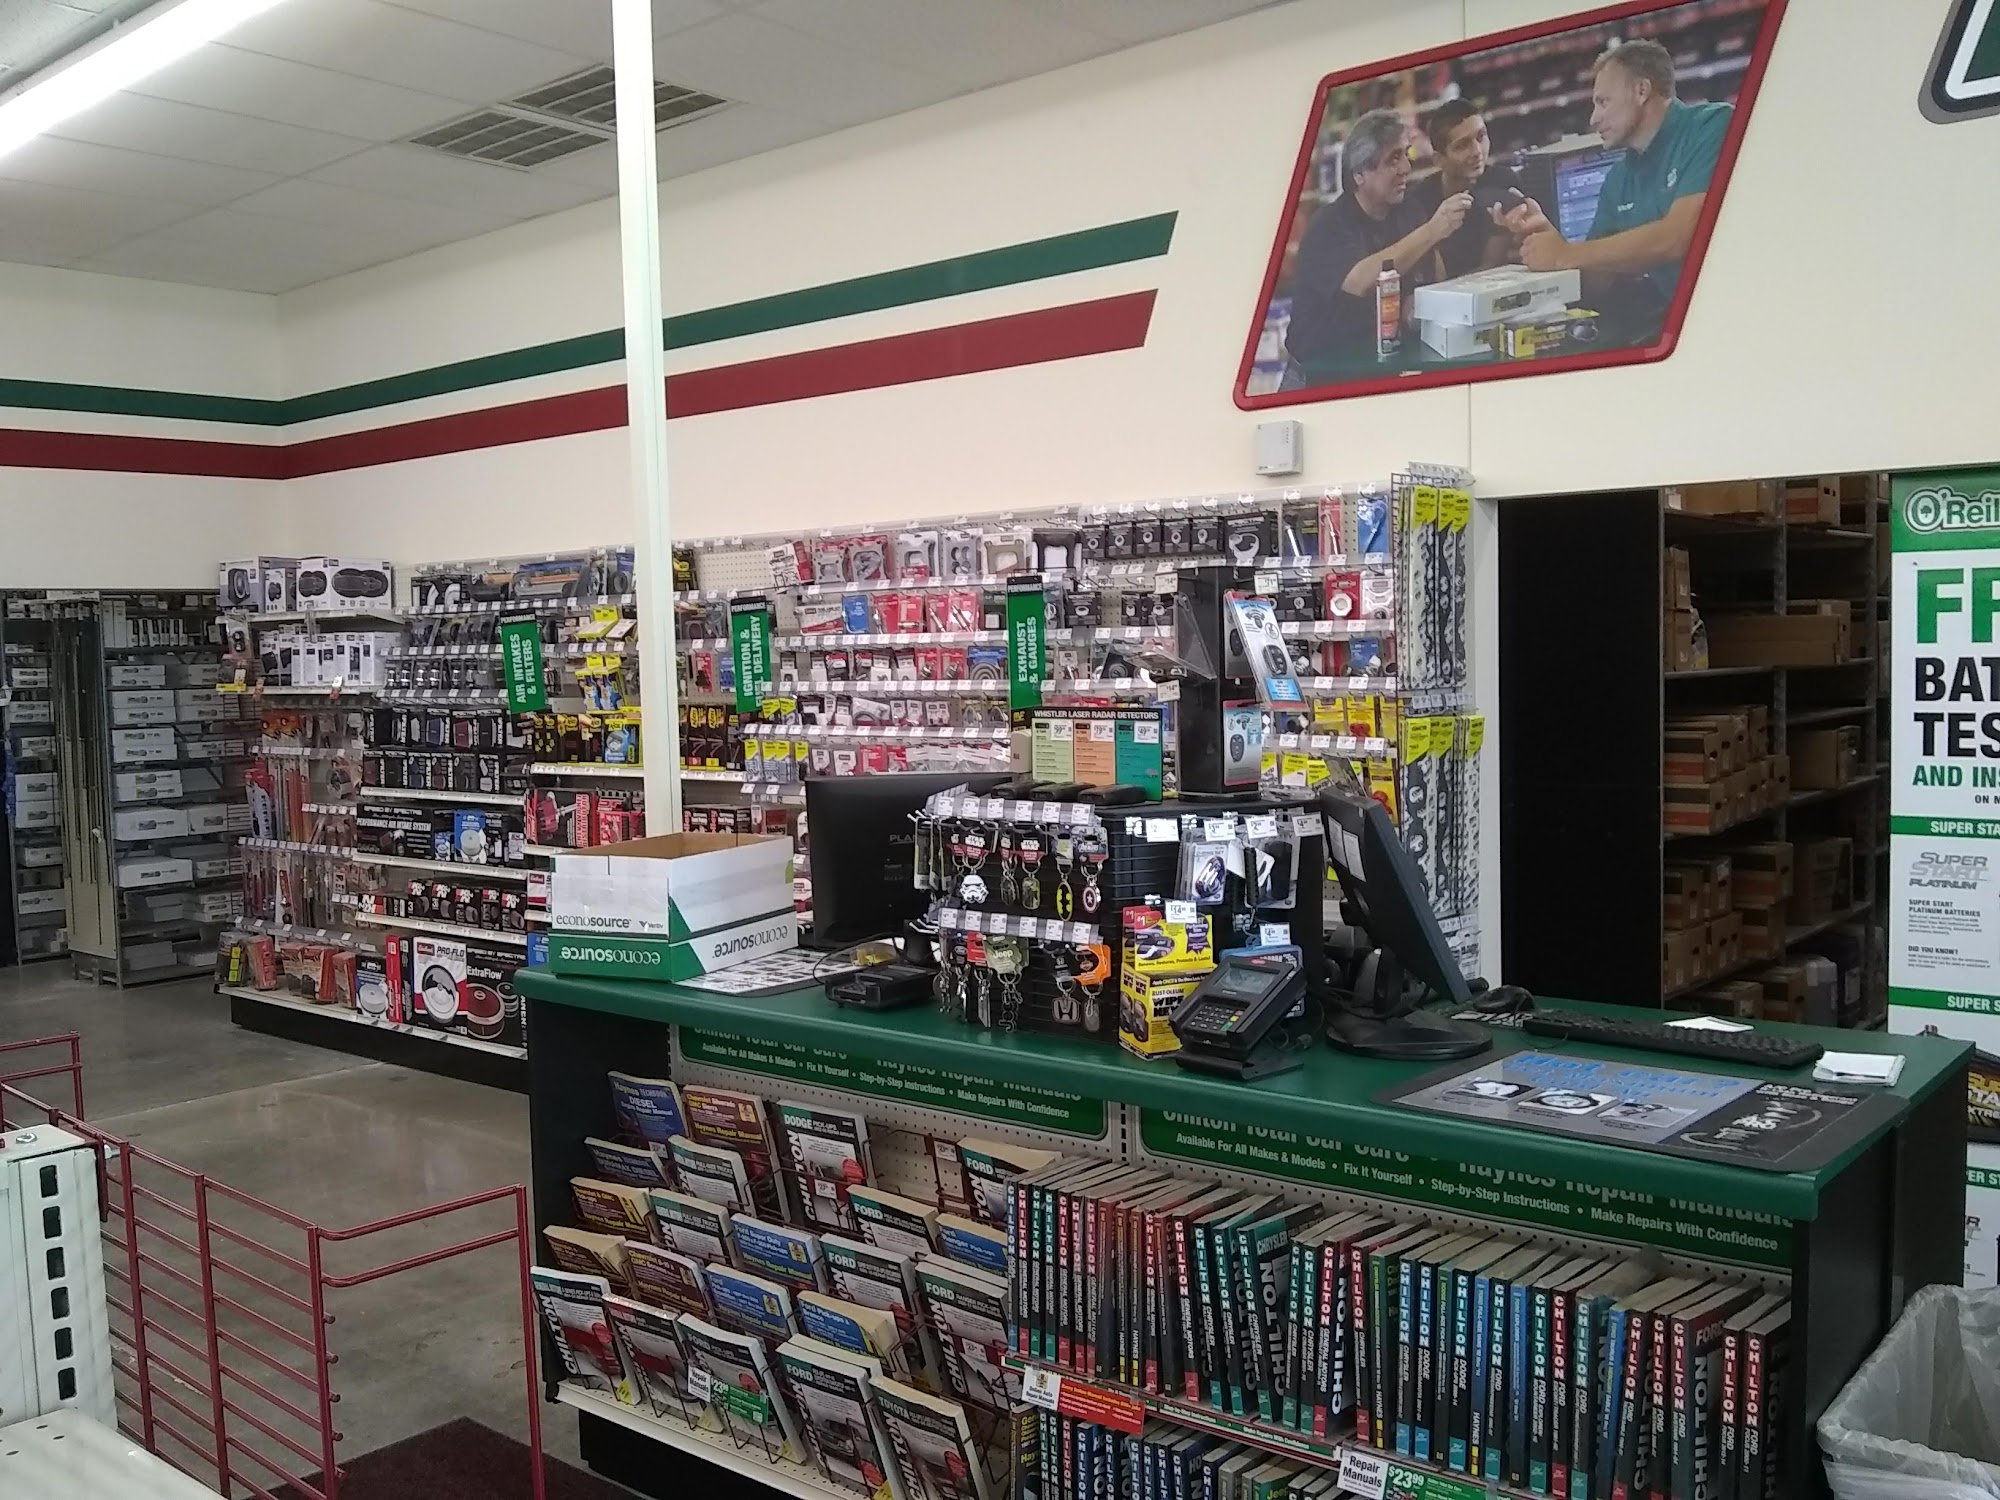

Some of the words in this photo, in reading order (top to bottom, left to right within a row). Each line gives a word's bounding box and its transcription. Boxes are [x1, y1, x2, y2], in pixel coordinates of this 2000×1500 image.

[731, 602, 766, 612] PERFORMANCE
[1007, 583, 1043, 593] PERFORMANCE
[501, 614, 535, 623] PERFORMANCE
[740, 629, 750, 639] &
[510, 633, 524, 681] INTAKES
[522, 639, 535, 682] FILTERS
[750, 616, 763, 674] DELIVERY
[1016, 621, 1028, 682] EXHAUST
[1027, 616, 1038, 669] GAUGES
[527, 685, 537, 694] &
[741, 643, 753, 696] IGNITION
[1029, 673, 1038, 684] &
[1915, 656, 2000, 702] BAT
[515, 683, 526, 703] AIR
[1034, 710, 1067, 718] WHISTLER
[1068, 710, 1090, 718] LASER
[1091, 711, 1116, 719] RADAR
[1117, 711, 1158, 719] DETECTORS
[1913, 712, 2000, 758] TES
[1912, 765, 1963, 787] AND
[1972, 766, 2000, 788] IN
[1975, 794, 1989, 804] ON
[356, 818, 388, 828] PERFORMANCE
[397, 821, 412, 829] INTAKE
[766, 826, 785, 834] Holley
[1930, 820, 1973, 835] SUPER
[1920, 852, 1988, 867] SUPER
[1909, 879, 1977, 890] PLATINUM
[1909, 899, 1930, 907] SUPER
[1933, 900, 1953, 908] START
[556, 912, 630, 929] econosource
[1909, 907, 1942, 915] PLATINUM
[1944, 908, 1981, 917] BATTERIES
[436, 946, 464, 957] PRO-FLO
[560, 946, 661, 965] econosource
[712, 926, 788, 959] econosource
[993, 949, 1013, 960] Jeep
[1921, 946, 1934, 954] YOU
[1935, 947, 1959, 955] KNOW?
[466, 966, 501, 980] ExtraFlow
[1152, 989, 1184, 997] RUST-OLEUM
[1947, 996, 1990, 1012] SUPER
[613, 1082, 640, 1096] Haynes
[629, 1096, 657, 1109] DIESEL
[702, 1043, 727, 1056] Available
[728, 1048, 737, 1057] For
[738, 1050, 747, 1058] All
[748, 1052, 767, 1063] Makes
[769, 1055, 774, 1064] &
[775, 1056, 796, 1068] Models
[807, 1061, 816, 1071] Fix
[818, 1063, 823, 1071] It
[824, 1064, 849, 1078] Yourself
[860, 1072, 903, 1090] Step-by-Step
[904, 1080, 945, 1096] Instructions
[958, 1089, 977, 1102] Make
[978, 1093, 1006, 1107] Repairs
[1008, 1098, 1025, 1111] With
[1027, 1102, 1069, 1118] Confidence
[694, 1123, 716, 1133] Haynes
[717, 1127, 737, 1137] Repair
[738, 1131, 763, 1140] Manual
[784, 1114, 813, 1129] DODGE
[813, 1120, 837, 1131] PICK-UPS
[787, 1129, 815, 1221] CHILTON
[966, 1157, 994, 1175] FORD
[853, 1202, 884, 1220] FORD
[1176, 1132, 1215, 1150] Available
[1218, 1140, 1233, 1152] For
[1235, 1142, 1247, 1154] All
[1249, 1145, 1279, 1161] Makes
[1281, 1151, 1288, 1162] &
[1291, 1153, 1326, 1170] Models
[1344, 1162, 1359, 1175] Fix
[1361, 1165, 1369, 1178] It
[1371, 1167, 1412, 1185] Yourself
[1431, 1178, 1501, 1203] Step-by-Step
[1503, 1191, 1570, 1215] Instructions
[1591, 1206, 1623, 1225] Make
[1627, 1213, 1673, 1233] Repairs
[1675, 1221, 1704, 1239] With
[1706, 1227, 1778, 1251] Confidence
[1007, 1185, 1015, 1259] CHILTON
[1018, 1189, 1027, 1258] CHILTON
[1032, 1189, 1040, 1259] CHILTON
[1045, 1194, 1053, 1263] CHILTON
[1059, 1196, 1067, 1266] CHILTON
[1086, 1203, 1095, 1277] CHILTON
[1256, 1231, 1289, 1255] CHRYSLER
[828, 1252, 856, 1269] FORD
[1145, 1213, 1155, 1286] CHILTON
[1174, 1221, 1188, 1296] CHILTON
[1195, 1228, 1211, 1304] CHILTON
[1214, 1235, 1230, 1310] CHILTON
[1238, 1234, 1256, 1311] CHILTON
[1289, 1246, 1299, 1321] CHILTON
[1304, 1251, 1316, 1328] CHILTON
[1320, 1246, 1334, 1326] CHILTON
[1352, 1250, 1364, 1329] CHILTON
[1400, 1262, 1411, 1344] CHILTON
[1259, 1262, 1286, 1396] CHILTON
[1419, 1267, 1431, 1347] CHILTON
[1455, 1275, 1468, 1357] CHILTON
[1491, 1284, 1505, 1367] CHILTON
[539, 1293, 580, 1375] CHILTON
[928, 1298, 967, 1394] CHILTON
[1332, 1277, 1347, 1415] CHILTON
[1534, 1294, 1546, 1377] CHILTON
[1553, 1295, 1565, 1379] CHILTON
[1576, 1303, 1590, 1388] CHILTON
[786, 1364, 813, 1381] FORD
[1624, 1317, 1642, 1399] CHILTON
[1652, 1320, 1664, 1406] CHILTON
[1673, 1322, 1685, 1409] CHILTON
[1722, 1335, 1736, 1423] CHILTON
[1029, 1386, 1042, 1394] Online
[1746, 1338, 1761, 1426] CHILTON
[880, 1397, 910, 1419] TOYOTA
[1472, 1411, 1480, 1445] HAYNES
[1040, 1412, 1050, 1481] CHILTON
[1050, 1416, 1058, 1485] CHILTON
[1063, 1420, 1072, 1489] CHILTON
[1349, 1455, 1380, 1474] Repair
[1343, 1466, 1382, 1488] Manuals
